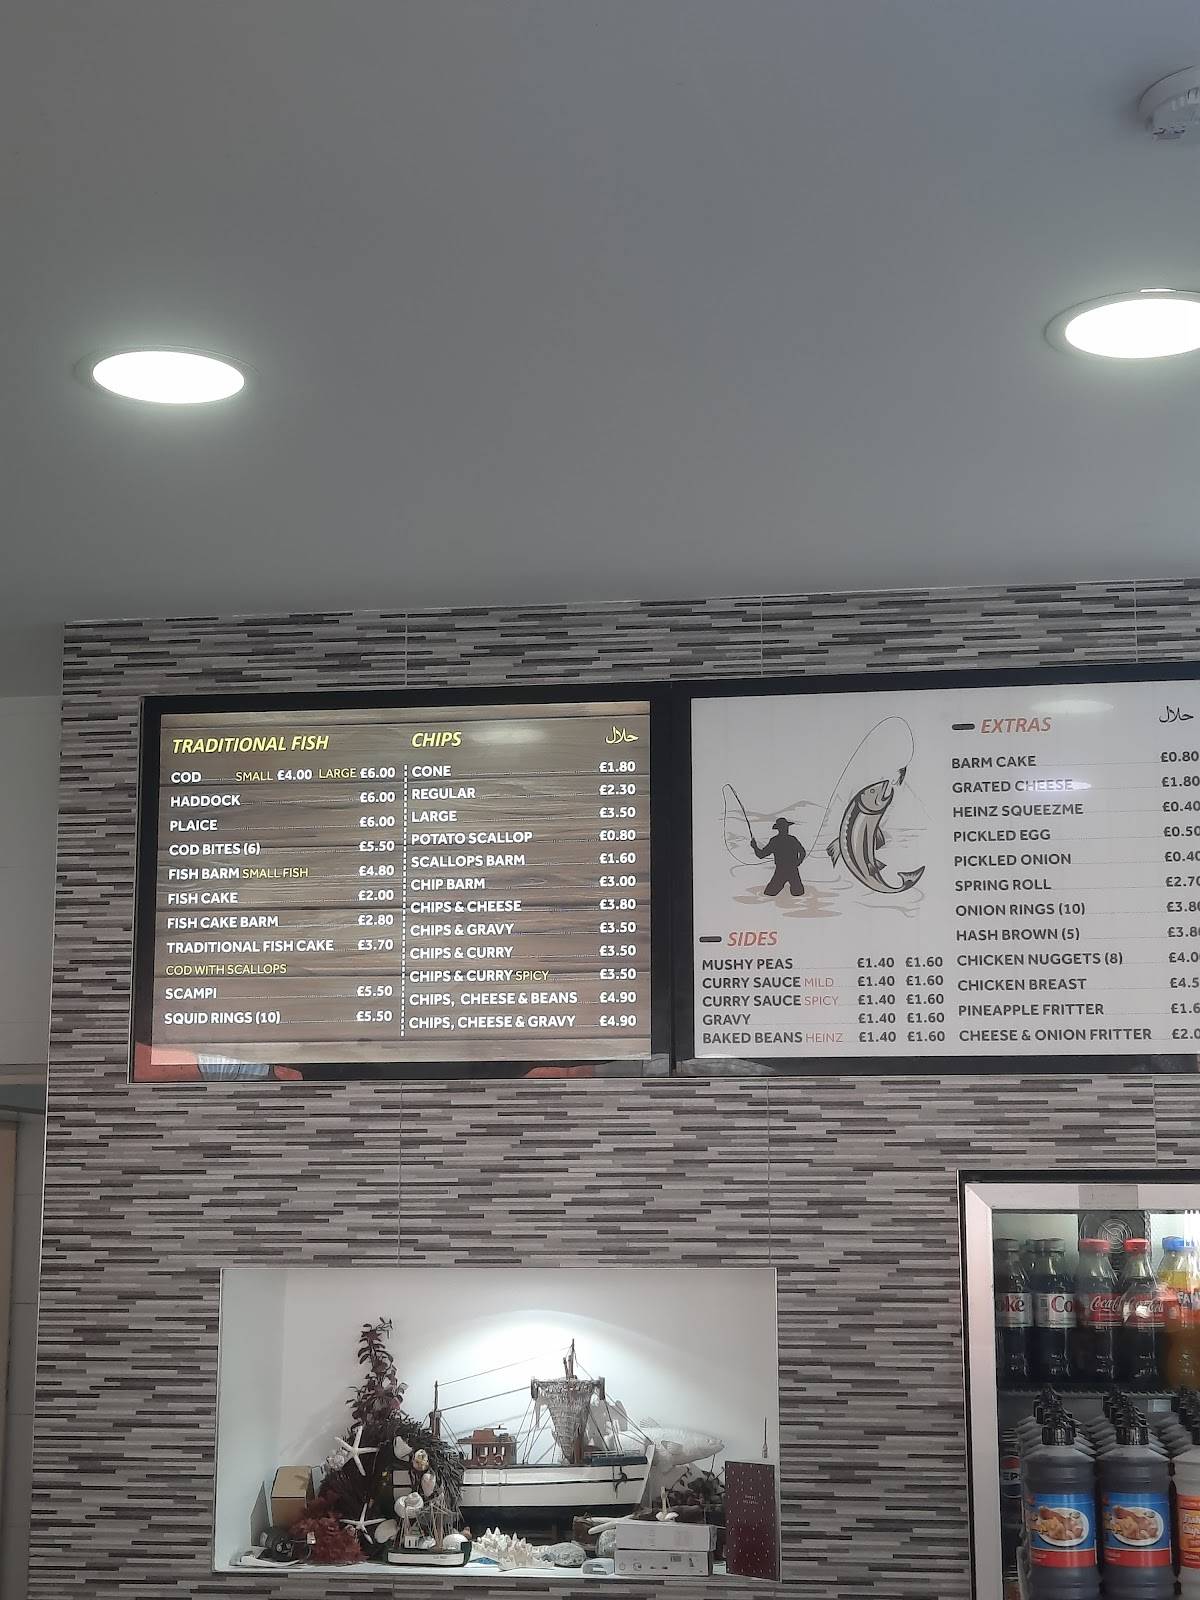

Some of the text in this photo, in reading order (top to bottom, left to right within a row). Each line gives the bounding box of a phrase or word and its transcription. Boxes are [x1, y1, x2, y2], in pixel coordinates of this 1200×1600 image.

[1159, 706, 1194, 723] حلال
[981, 717, 1052, 734] EXTRAS
[411, 732, 462, 747] CHIPS
[605, 726, 639, 744] حلال
[172, 735, 329, 754] TRADITIONAL FISH
[952, 751, 1199, 769] BARM CAKE £0.80
[171, 767, 396, 783] COD SMALL £4.00 LARGE £6.00
[412, 761, 636, 777] CONE £1.80
[412, 784, 636, 800] REGULAR £2.30
[952, 776, 1200, 793] GRATED CHEESE £1.80
[171, 792, 395, 807] HADDOCK £6.00
[412, 807, 636, 822] LARGE £3.50
[953, 801, 1200, 818] HEINZ SQUEEZME £0.40
[170, 816, 395, 831] PLAICE £6.00
[412, 829, 636, 845] POTATO SCALLOP £0.80
[954, 826, 1200, 842] PICKLED EGG £0.50
[169, 841, 395, 856] COD BITES (6) £5.50
[411, 852, 636, 868] SCALLOPS BARM £1.60
[954, 855, 1017, 866] PICKLED
[1021, 853, 1071, 865] ONION
[168, 865, 395, 880] FISH BARM SMALL FISH £4.80
[411, 875, 636, 890] CHIP BARM £3.00
[955, 879, 1009, 892] SPRING
[1012, 879, 1051, 890] ROLL
[168, 890, 394, 904] FISH CAKE £2.00
[410, 899, 636, 914] CHIPS & CHEESE £3.80
[955, 905, 1006, 917] ONION
[1009, 903, 1054, 915] RINGS
[1058, 903, 1085, 916] (10)
[167, 915, 394, 929] FISH CAKE BARM £2.80
[410, 921, 636, 937] CHIPS & GRAVY £3.50
[727, 931, 778, 947] SIDES
[956, 927, 1200, 941] HASH BROWN (5) £3.8
[167, 939, 393, 954] TRADITIONAL FISH CAKE £3.70
[410, 945, 636, 960] CHIPS & CURRY £3.50
[702, 956, 943, 971] MUSHY PEAS £1.40 £1.60
[957, 952, 1200, 967] CHICKEN NUGGETS (8) £4.0
[166, 964, 287, 976] COD WITH SCALLOPS
[409, 968, 636, 983] CHIPS & CURRY SPICY £3.50
[703, 975, 943, 989] CURRY SAUCE MILD £1.40 £1.60
[958, 979, 1025, 991] CHICKEN
[1029, 978, 1087, 990] BREAST
[165, 986, 393, 1000] SCAMPI £5.50
[409, 992, 637, 1007] CHIPS, CHEESE & BEANS £4.90
[703, 993, 944, 1008] CURRY SAUCE SPICY £1.40 £1.60
[958, 1004, 1039, 1016] PINEAPPLE
[1043, 1003, 1104, 1015] FRITTER
[164, 1010, 392, 1025] SQUID RINGS (10) £5.50
[409, 1015, 637, 1030] CHIPS, CHEESE & GRAVY £4.90
[703, 1012, 944, 1026] GRAVY £1.40 £1.60
[703, 1031, 945, 1044] BAKED BEANS HEINZ £1.40 £1.60
[959, 1030, 1018, 1042] CHEESE
[1021, 1030, 1031, 1041] &
[1035, 1029, 1086, 1041] ONION
[1090, 1028, 1152, 1040] FRITTER
